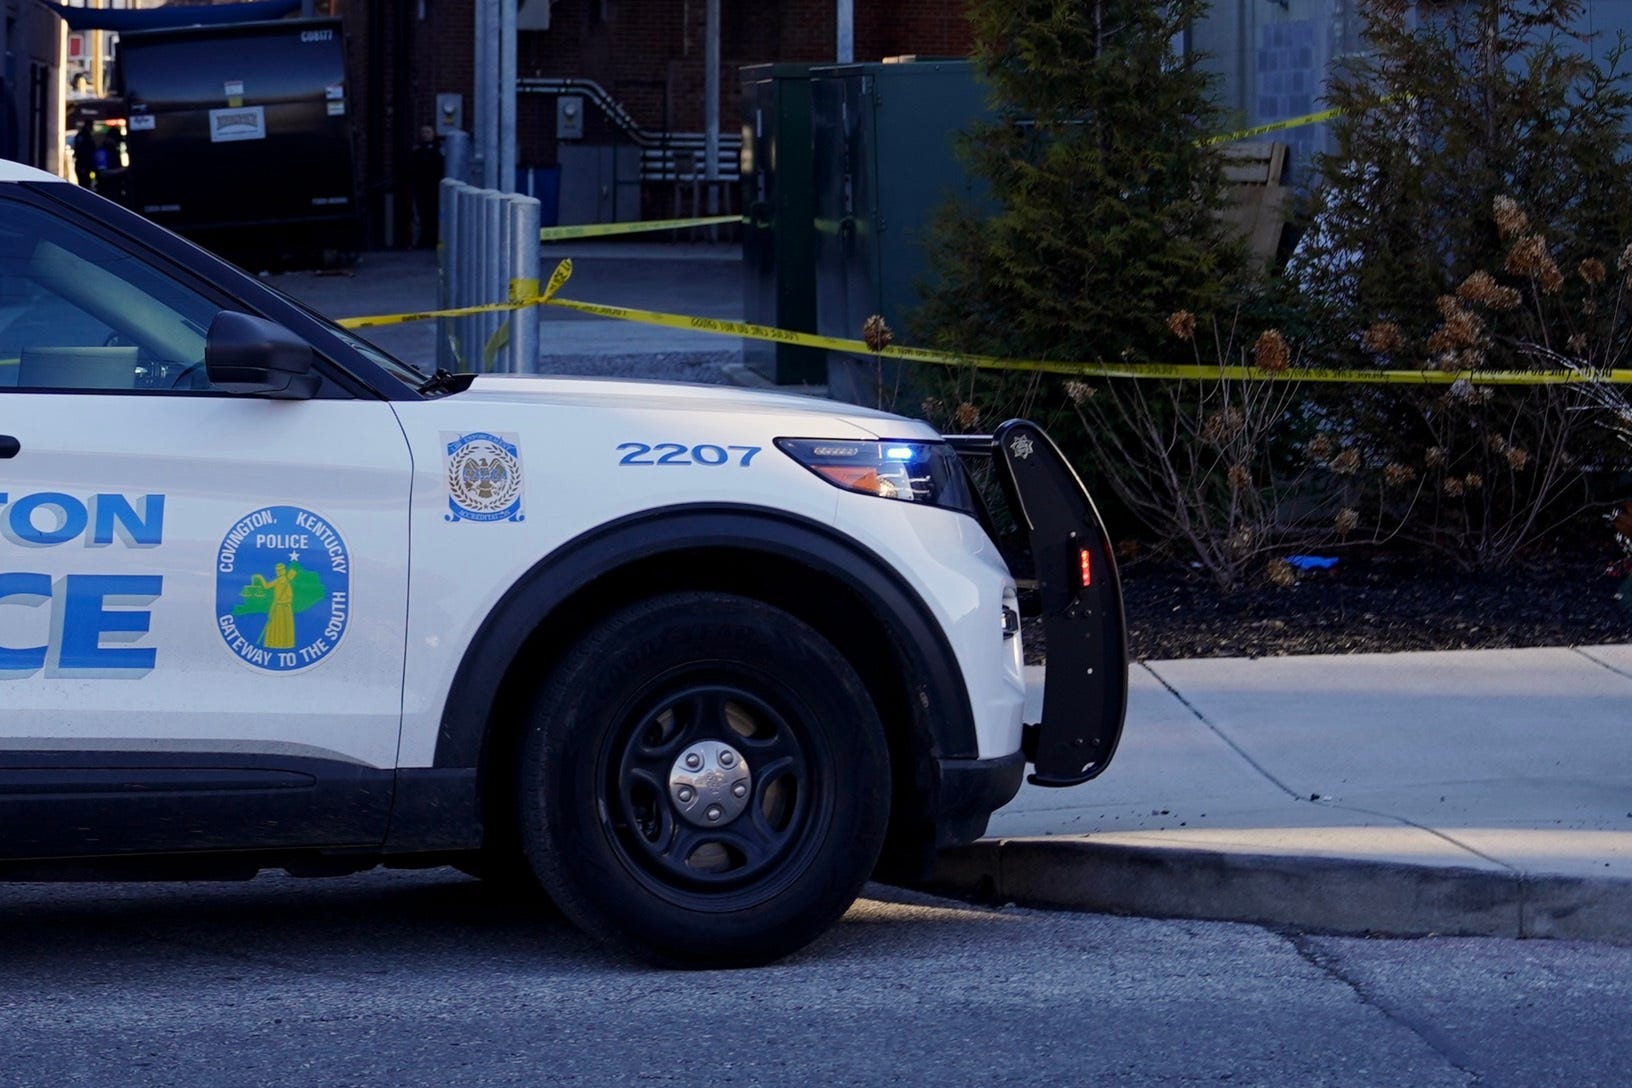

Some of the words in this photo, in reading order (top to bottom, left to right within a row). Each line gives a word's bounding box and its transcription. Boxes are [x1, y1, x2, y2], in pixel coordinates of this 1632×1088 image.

[616, 442, 762, 467] 2207
[256, 534, 309, 549] POLICE
[295, 511, 347, 574] KENTUCKY
[219, 614, 273, 667] GATEWAY
[277, 652, 297, 667] TO
[299, 638, 330, 663] THE
[323, 591, 346, 641] SOUTH
